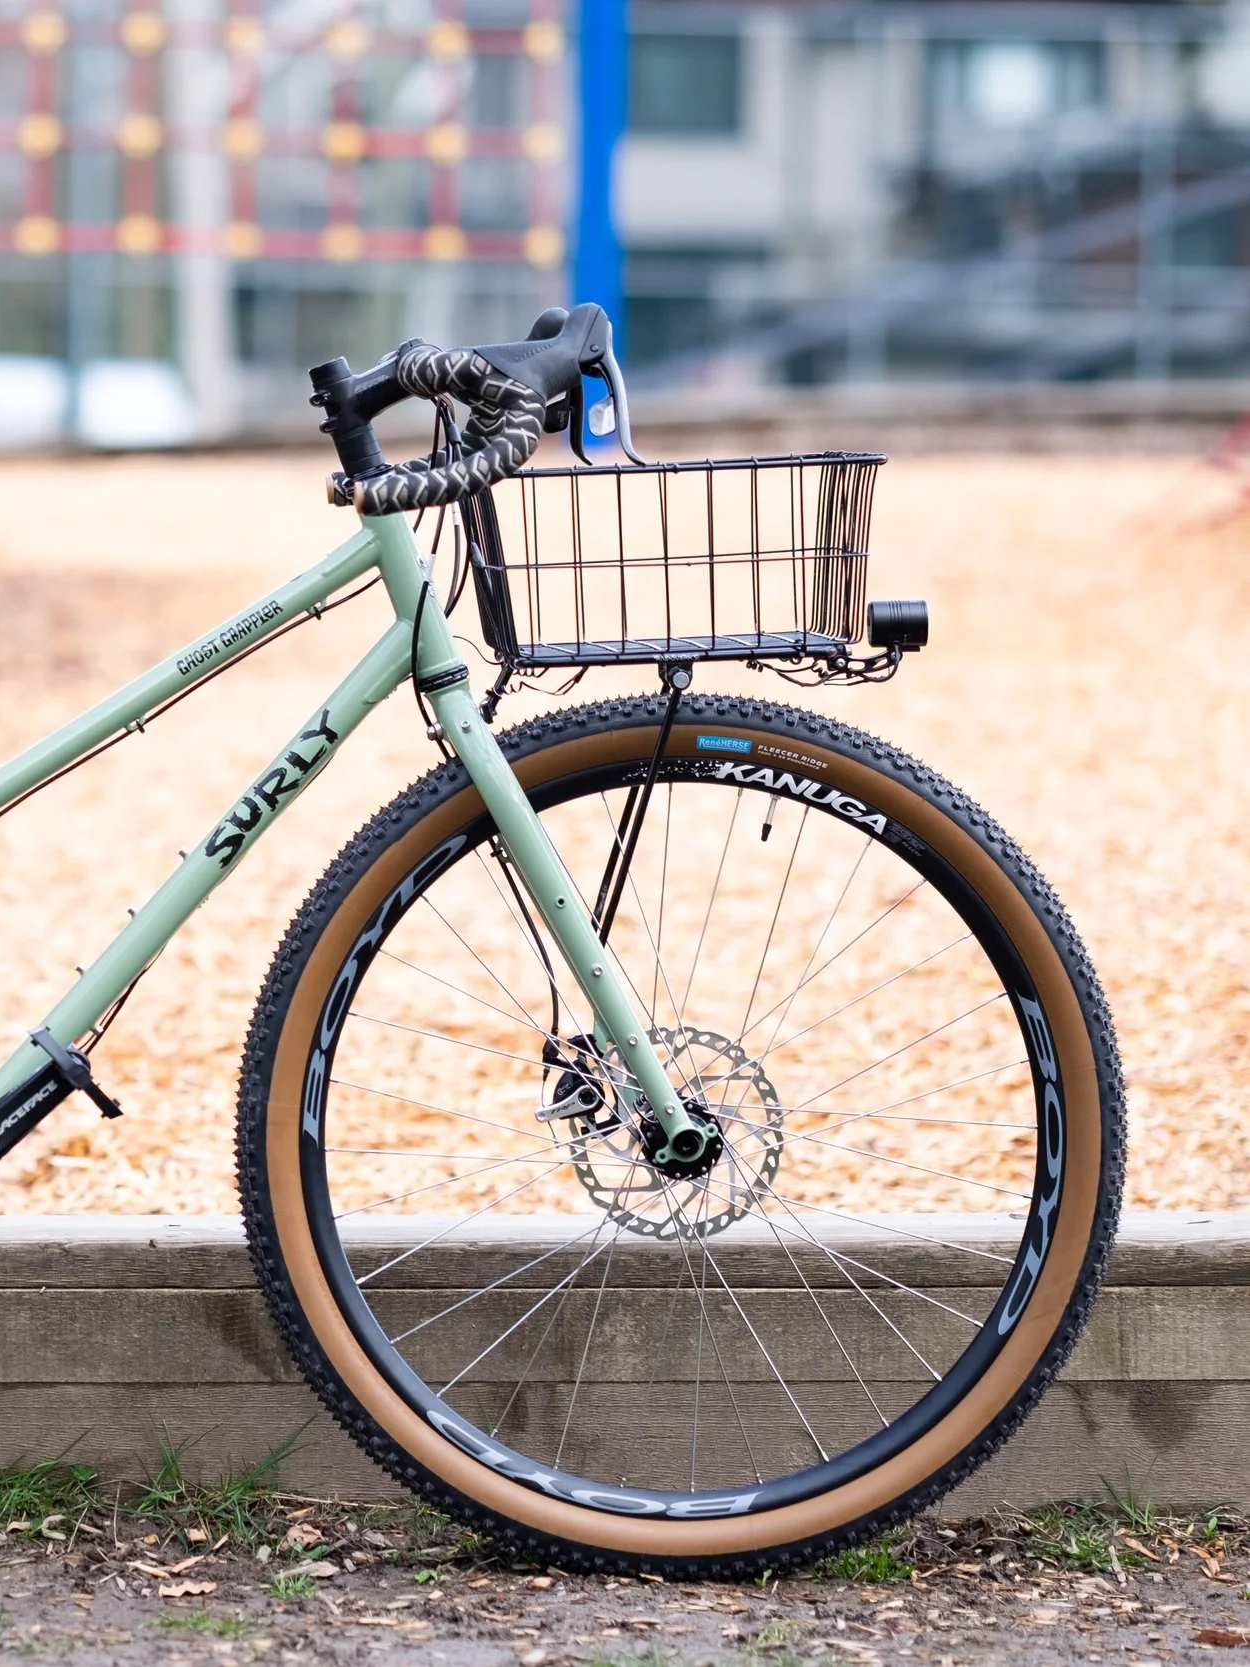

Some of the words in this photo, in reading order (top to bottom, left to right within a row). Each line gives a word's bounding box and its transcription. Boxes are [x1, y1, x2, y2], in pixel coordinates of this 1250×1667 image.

[177, 639, 221, 675] GHOST
[219, 600, 284, 648] GRAPPLER
[204, 709, 338, 869] SURLY
[699, 737, 750, 751] RenéHERSE
[757, 744, 798, 759] FLEECER
[800, 755, 828, 769] RIDGE
[715, 762, 888, 835] KANUGA
[303, 834, 467, 1147] BOYD
[997, 991, 1063, 1336] BOYD
[427, 1409, 762, 1518] BOYD
